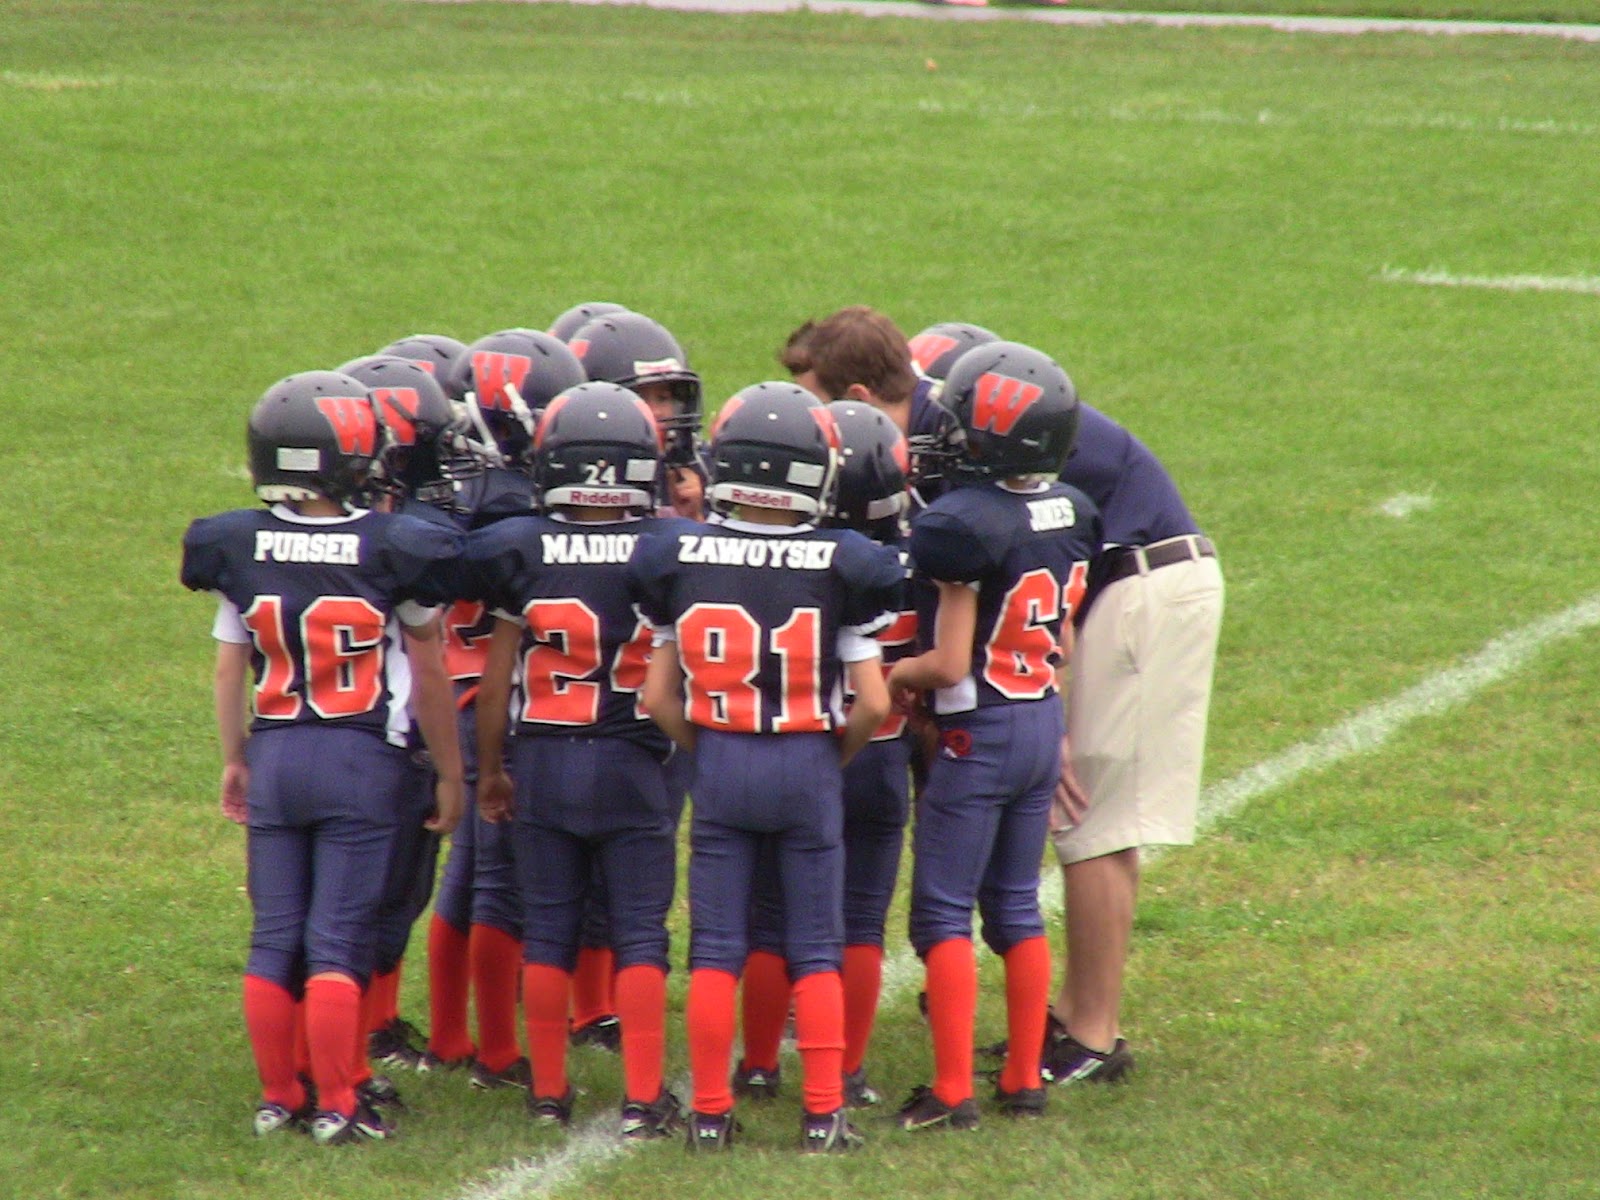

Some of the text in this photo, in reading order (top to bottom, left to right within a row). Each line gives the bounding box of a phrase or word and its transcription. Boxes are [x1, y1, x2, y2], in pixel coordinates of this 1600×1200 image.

[470, 351, 531, 412] W
[972, 372, 1043, 436] W
[313, 396, 376, 457] W
[584, 464, 616, 486] 24
[570, 490, 630, 504] Riddell
[731, 488, 793, 507] Riddell
[254, 529, 360, 565] PURSER
[541, 533, 639, 564] MADIO
[678, 535, 838, 570] ZAWOYSKI
[241, 595, 385, 719] 16
[676, 602, 831, 734] 81
